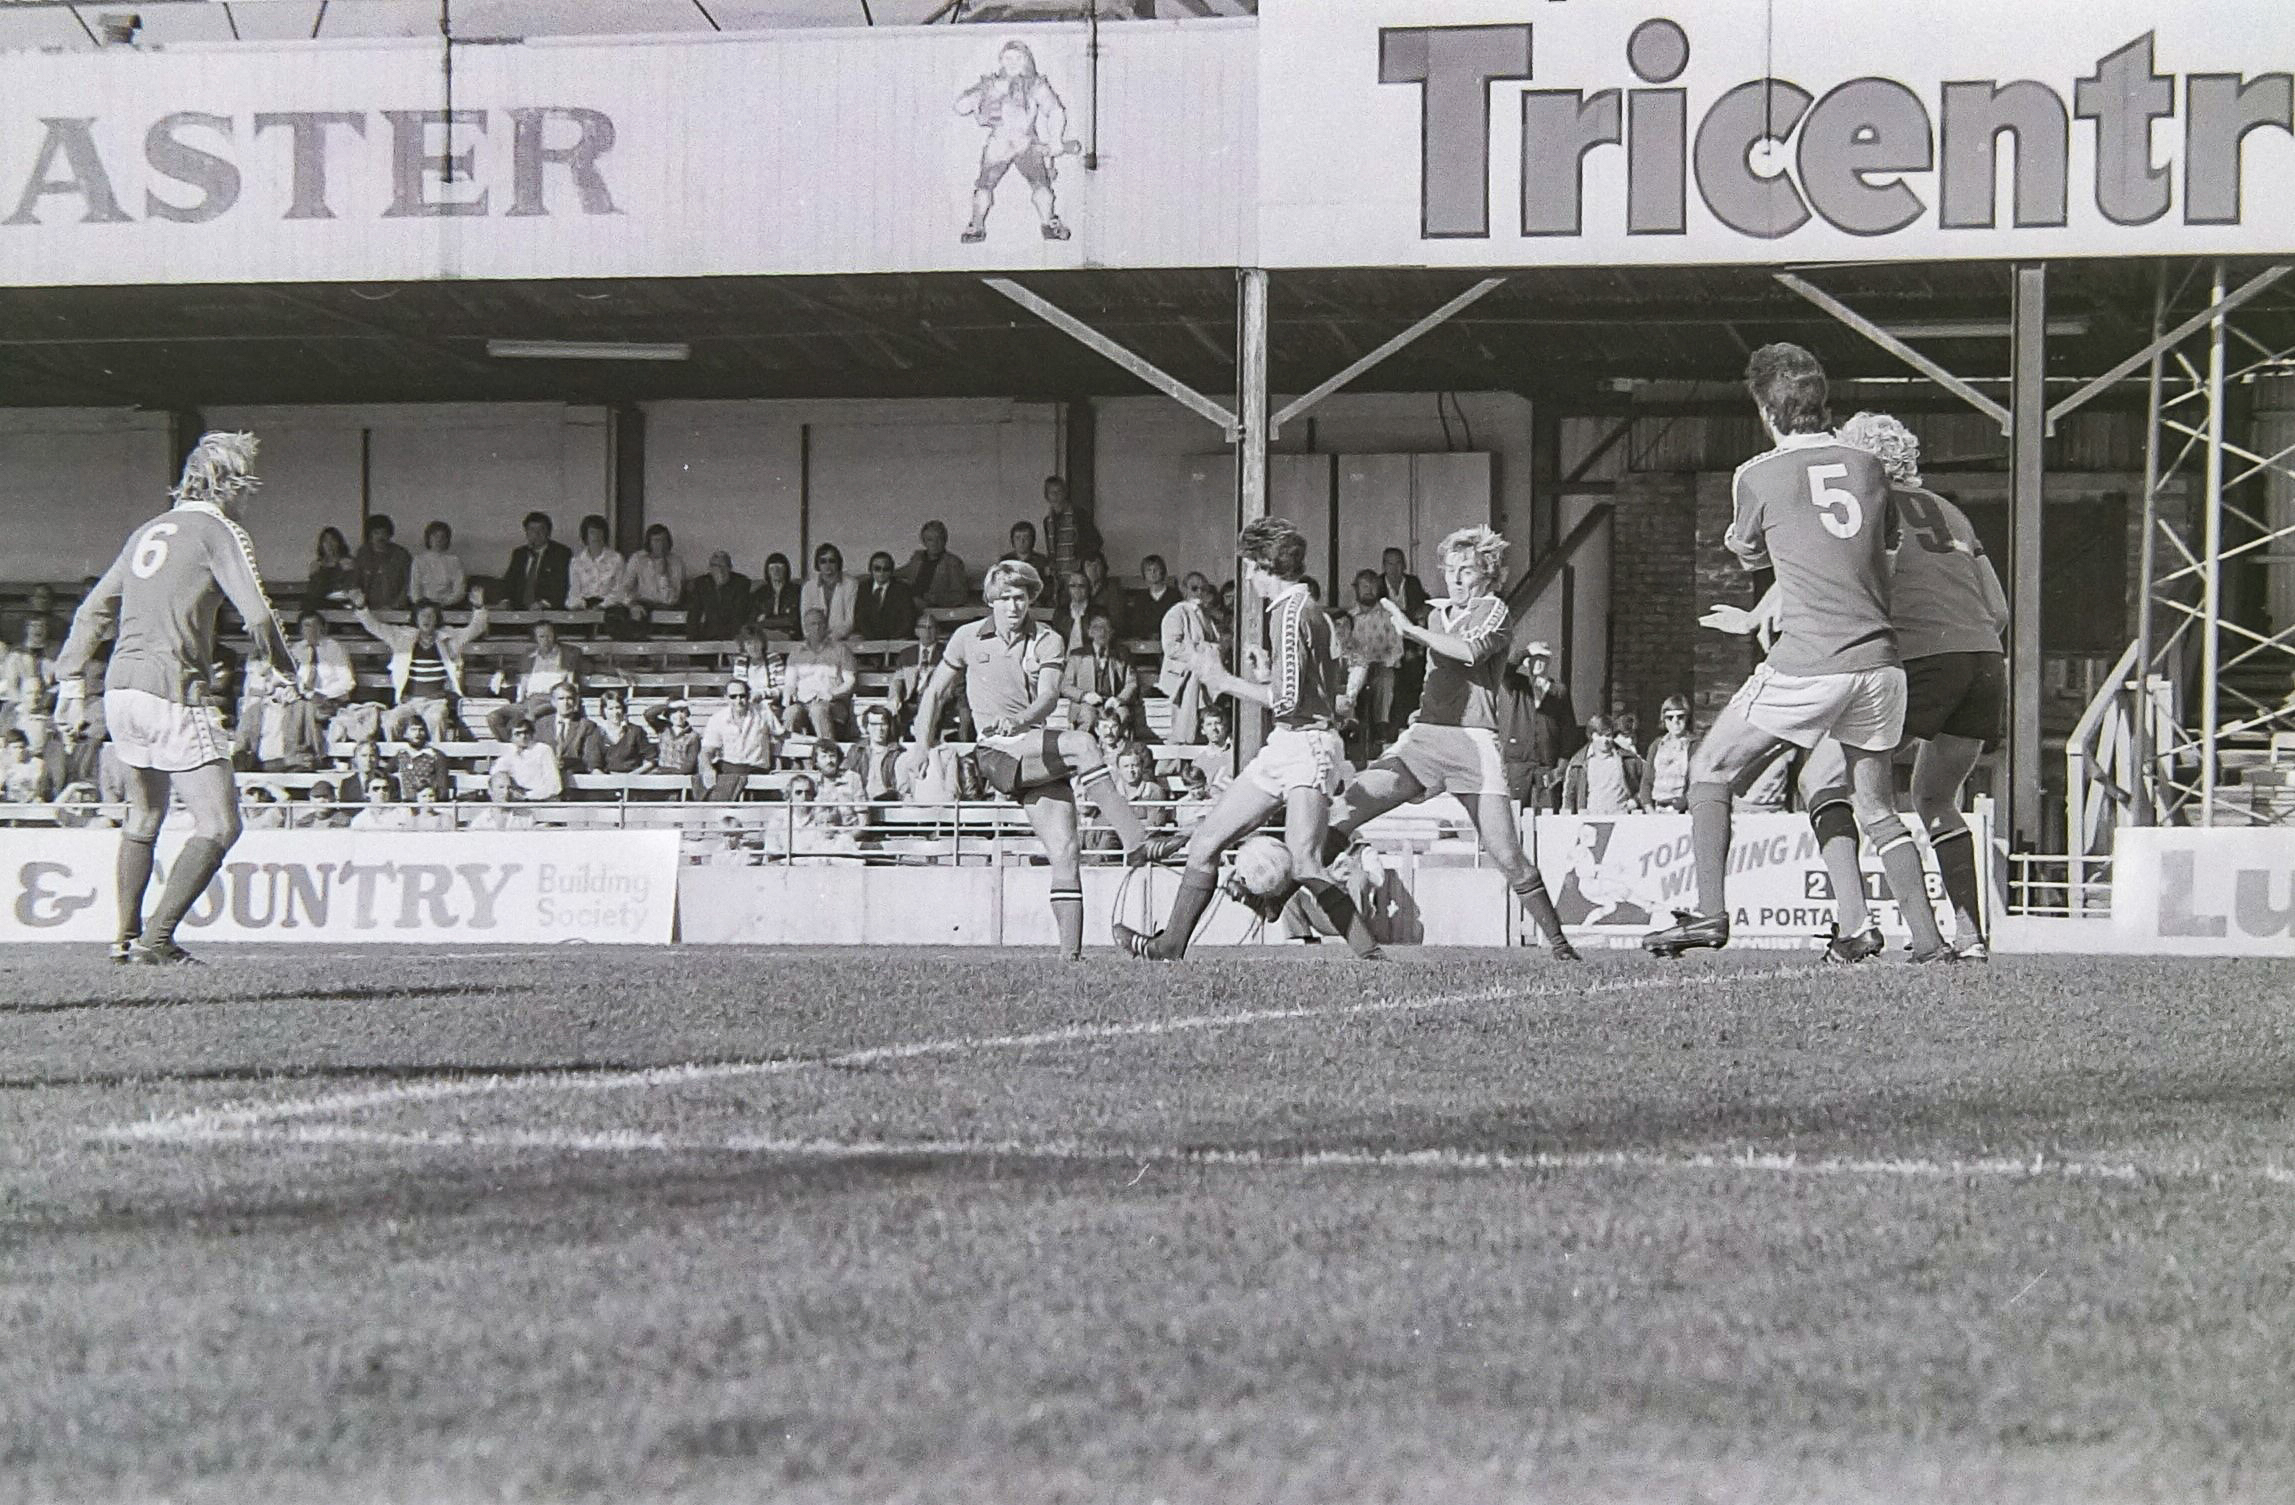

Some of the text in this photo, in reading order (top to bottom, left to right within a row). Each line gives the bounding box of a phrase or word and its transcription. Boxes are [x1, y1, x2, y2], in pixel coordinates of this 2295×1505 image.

[1378, 15, 2295, 240] Tricentr
[0, 105, 626, 225] ASTER
[1807, 463, 1863, 540] 5
[131, 522, 179, 580] 6
[14, 859, 524, 930] & OUNTRY
[537, 896, 650, 934] Society
[538, 863, 650, 903] Building
[1735, 907, 1750, 926] A
[1760, 907, 1881, 927] PORTAE
